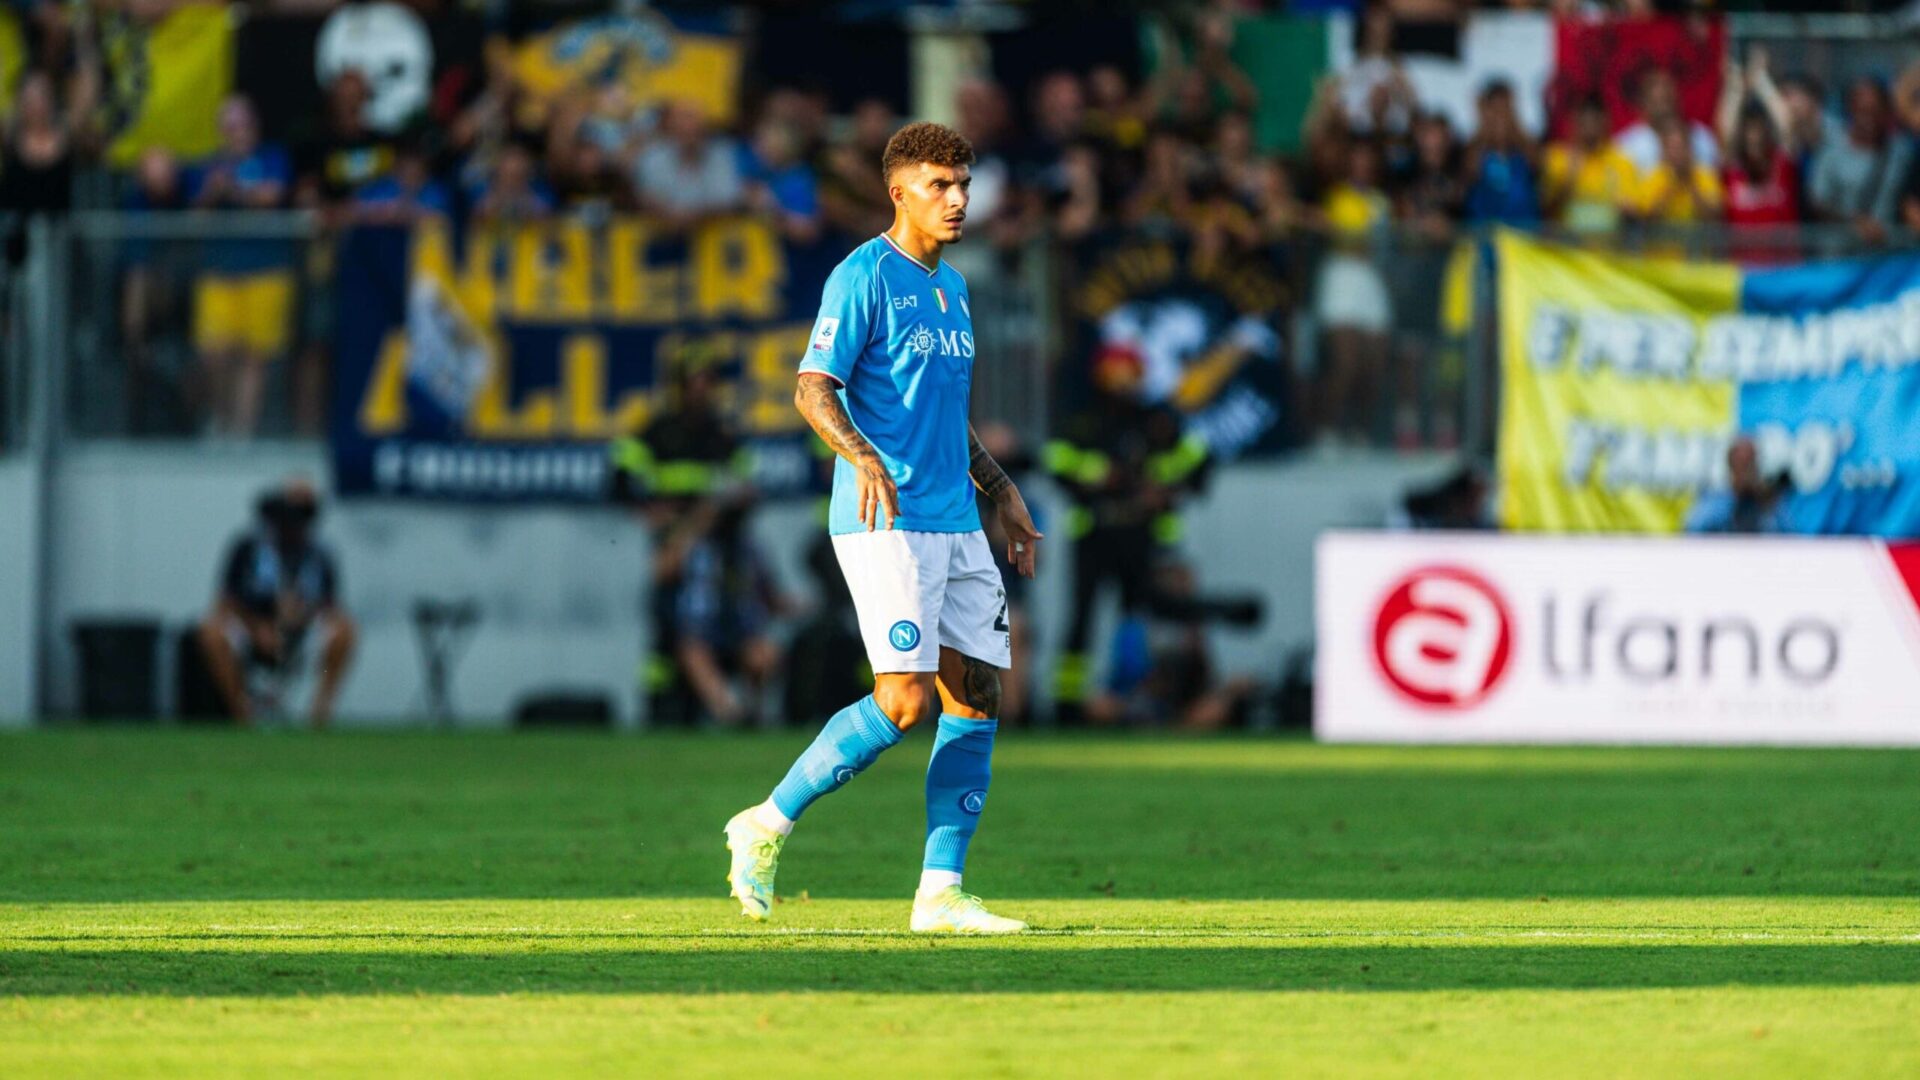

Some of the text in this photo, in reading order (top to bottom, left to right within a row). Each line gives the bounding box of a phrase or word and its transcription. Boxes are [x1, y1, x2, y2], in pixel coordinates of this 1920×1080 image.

[892, 295, 918, 310] EA7
[937, 328, 975, 358] MS
[896, 627, 912, 644] N
